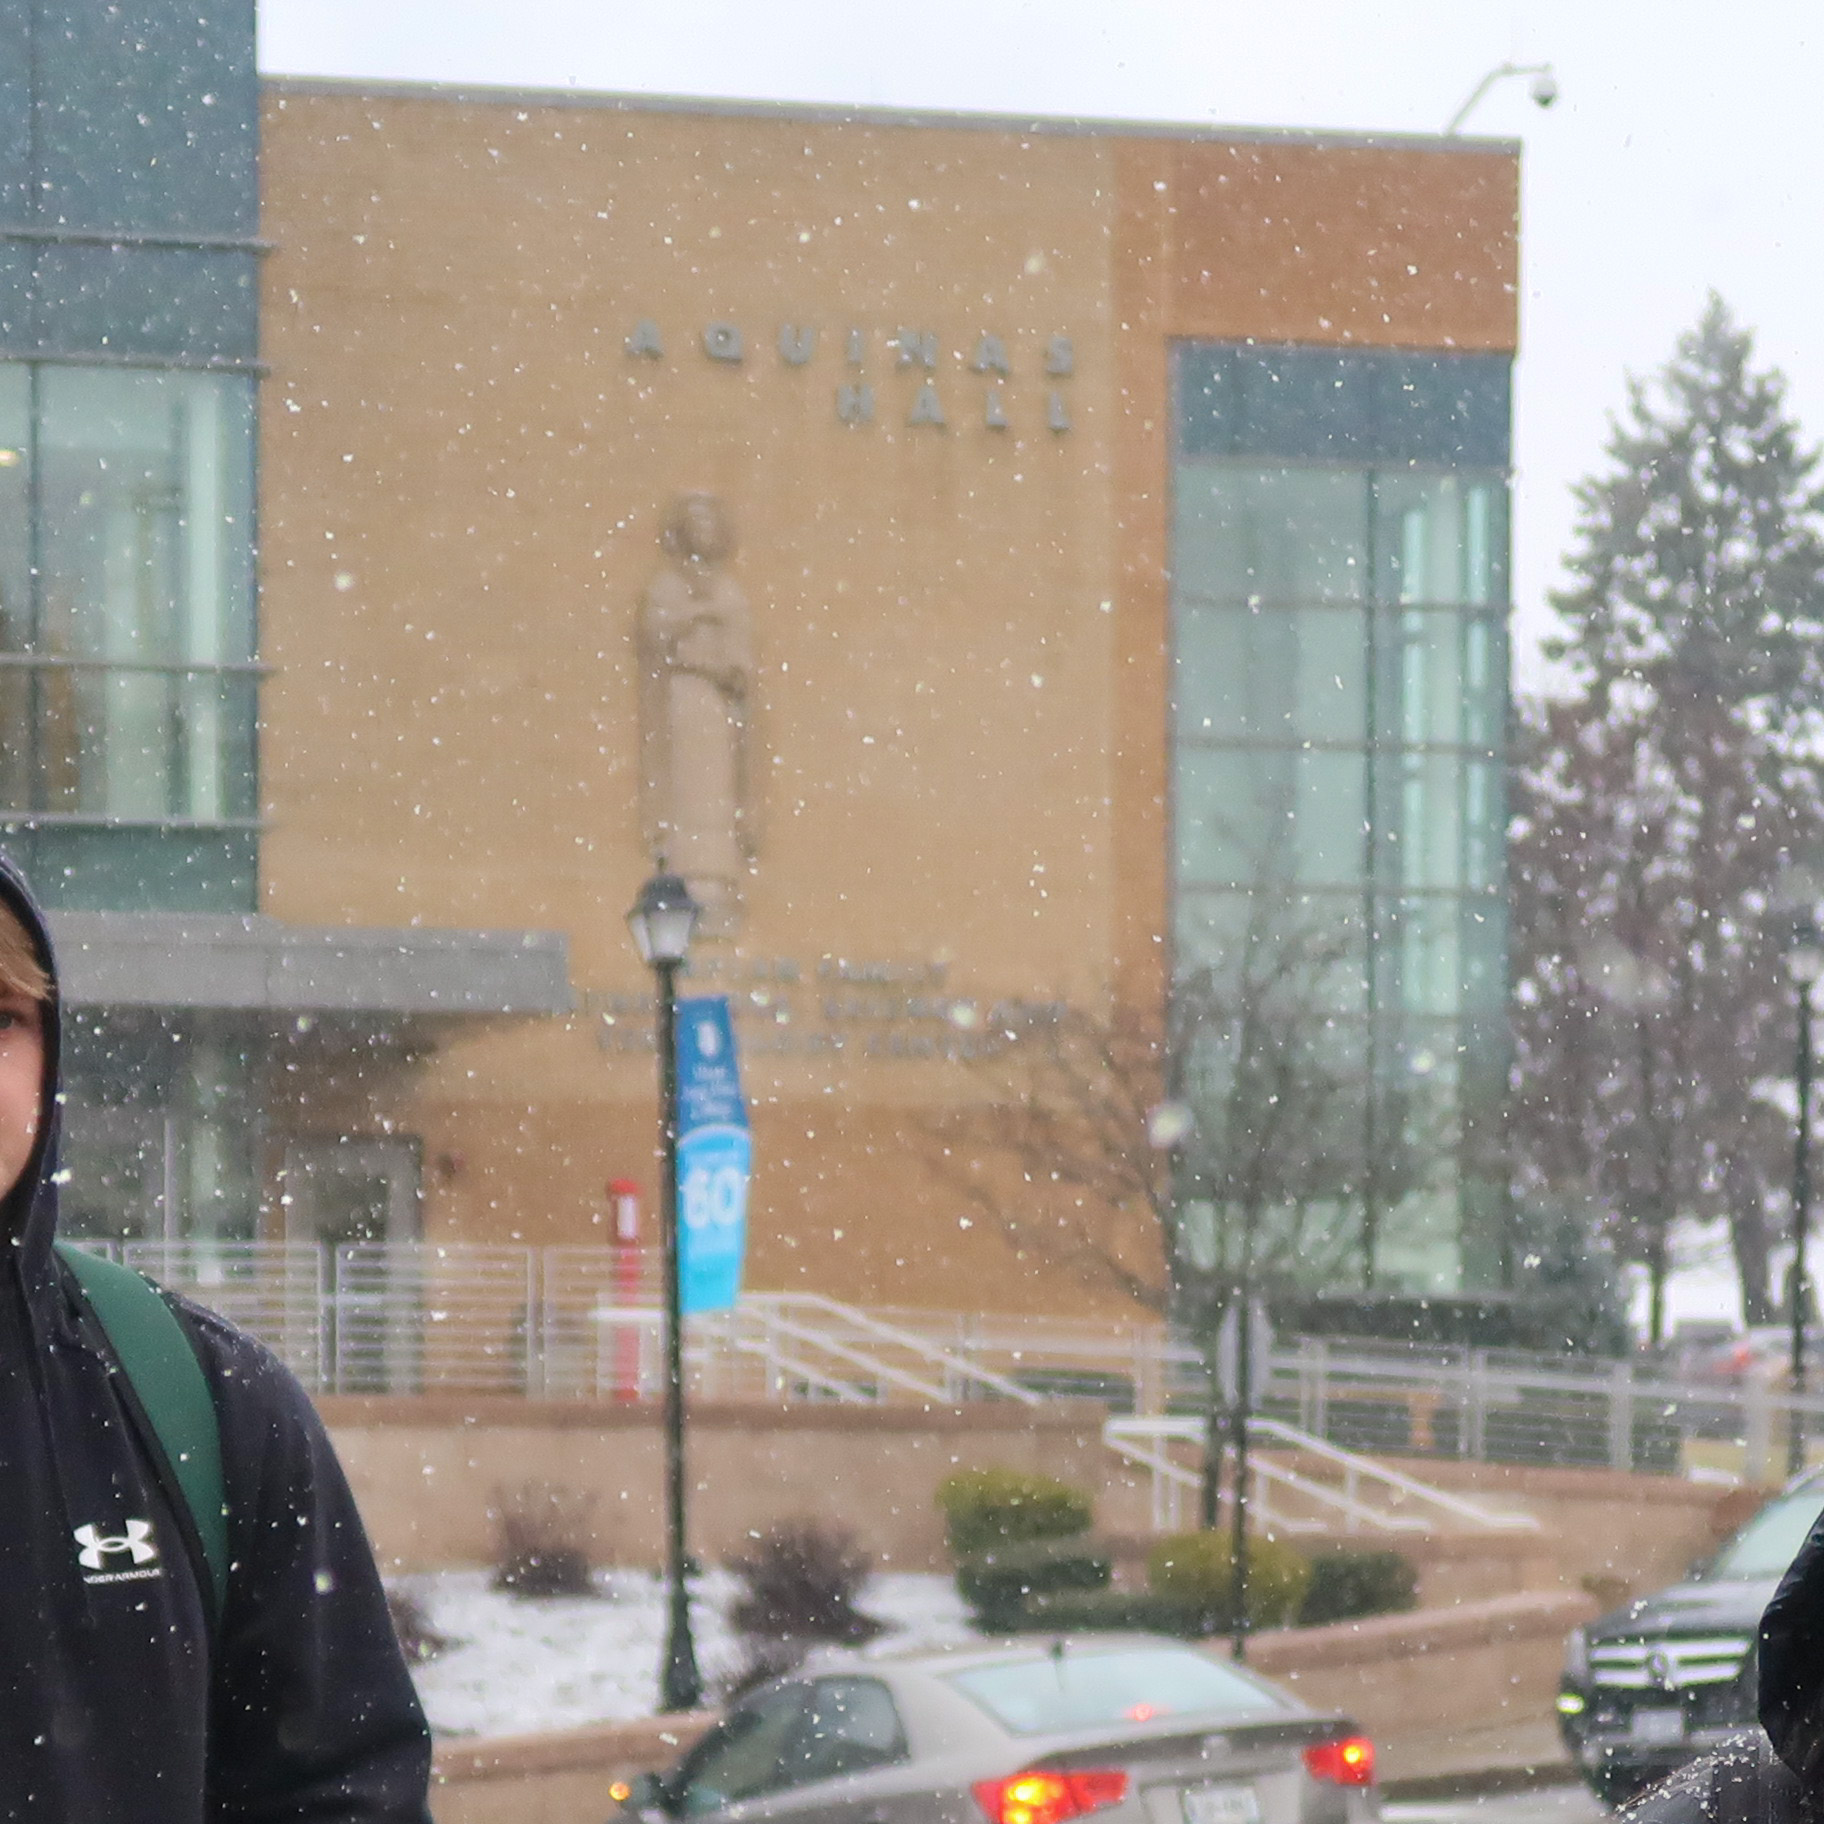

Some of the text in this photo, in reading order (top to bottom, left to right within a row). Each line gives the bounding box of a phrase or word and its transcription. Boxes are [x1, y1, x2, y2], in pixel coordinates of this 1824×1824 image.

[625, 317, 1074, 376] AQUINAS
[836, 380, 1072, 430] HALL
[684, 1166, 742, 1228] 60
